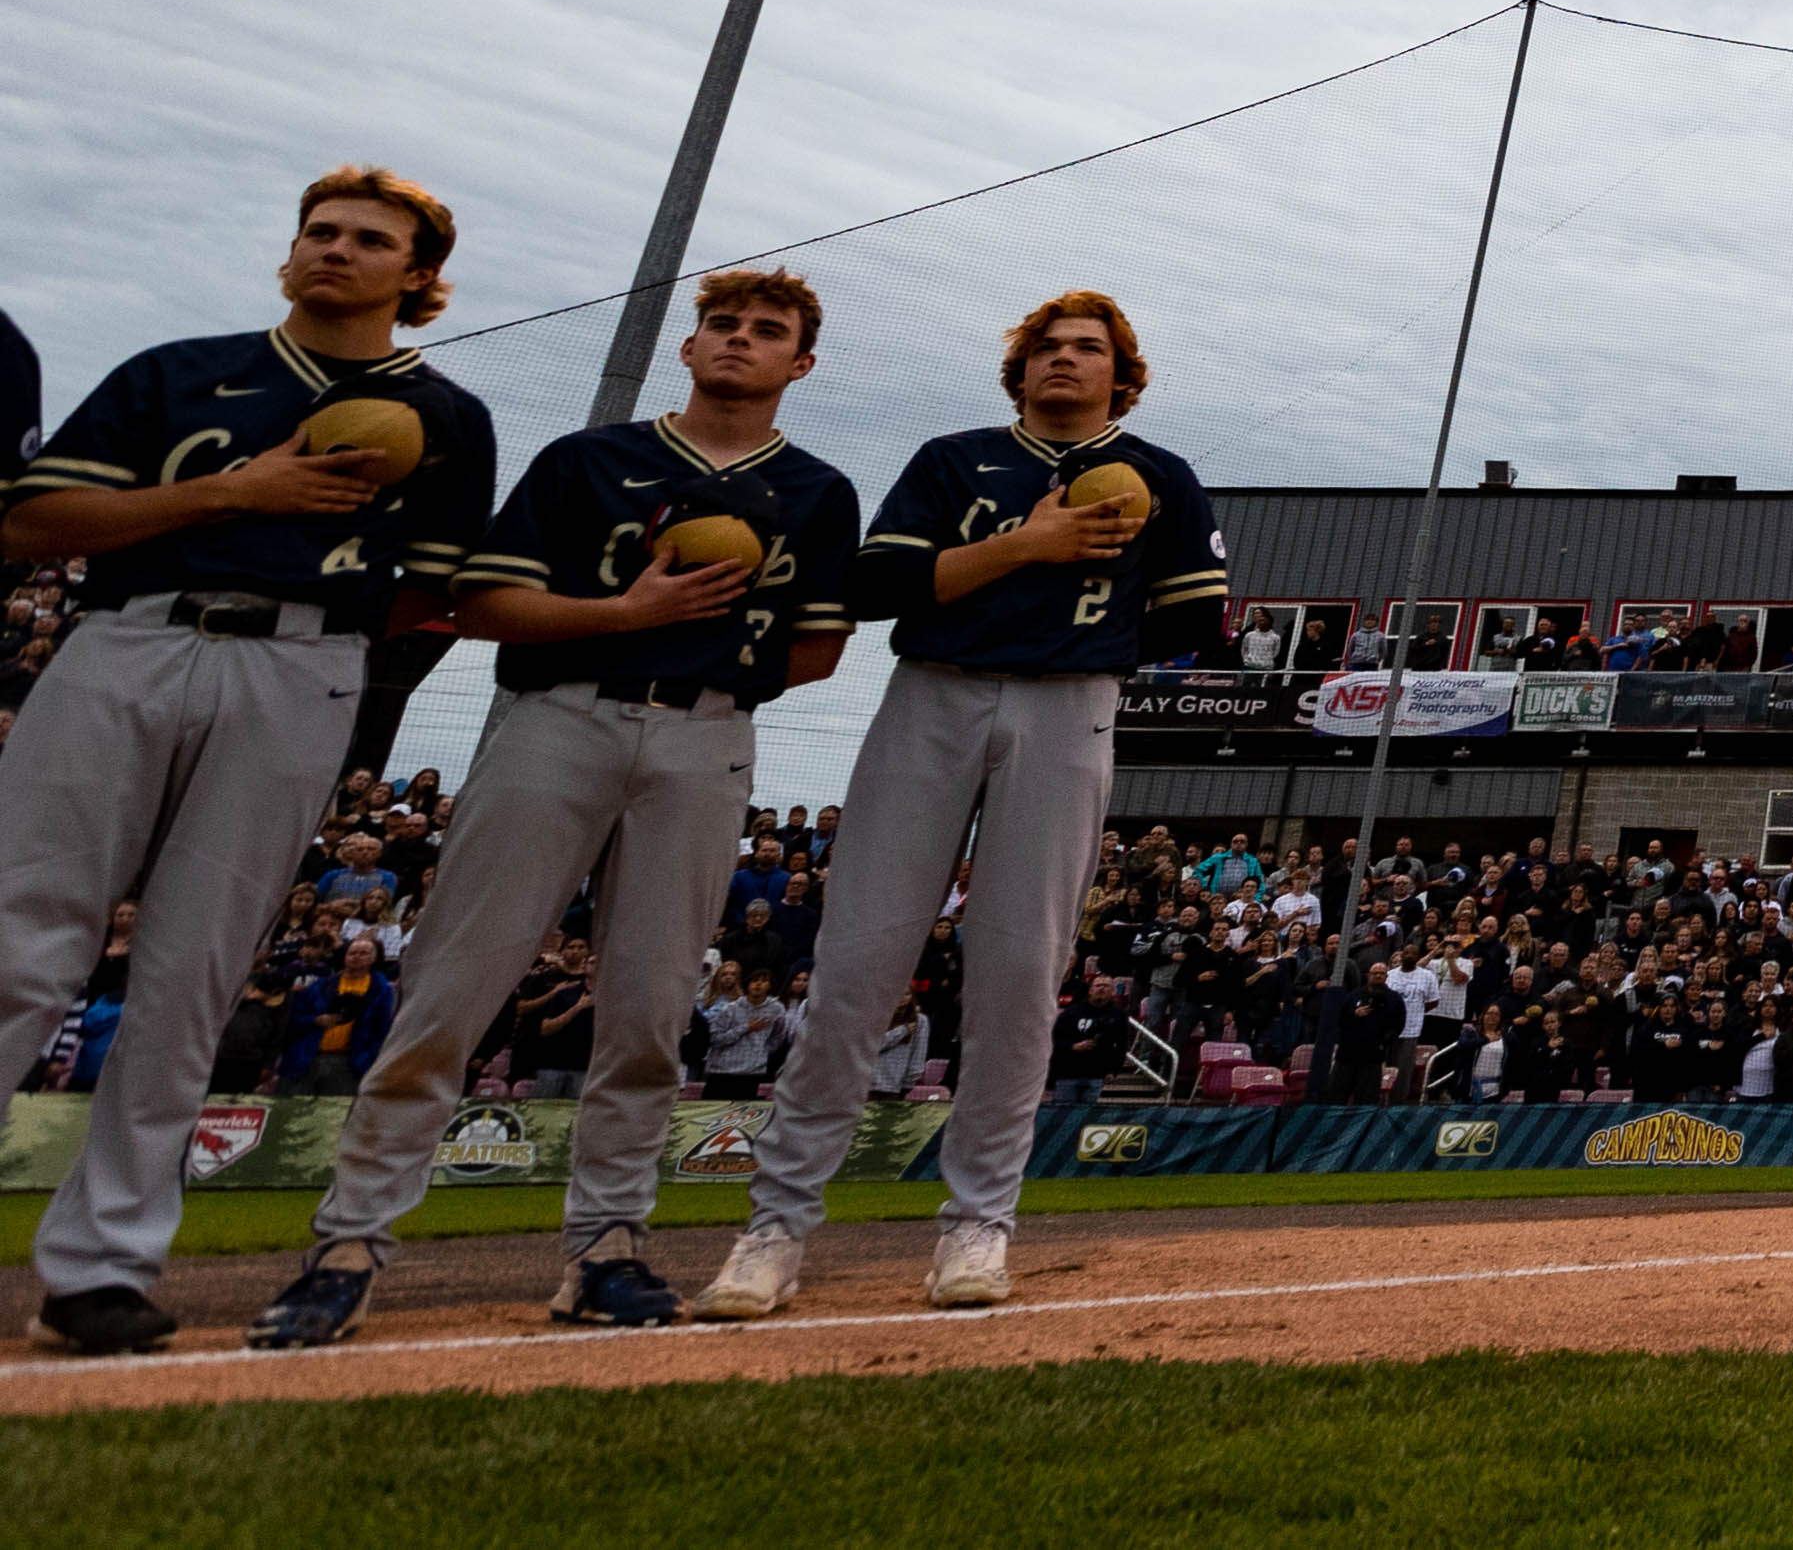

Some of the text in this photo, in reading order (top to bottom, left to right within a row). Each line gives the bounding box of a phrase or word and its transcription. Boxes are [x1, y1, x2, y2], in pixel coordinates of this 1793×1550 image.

[1072, 578, 1112, 626] 2
[1412, 680, 1486, 688] Northwest
[1176, 694, 1268, 715] GROUP
[1411, 689, 1457, 701] Sports
[1524, 684, 1609, 714] DICK'S
[1408, 702, 1497, 716] Photography
[1586, 1111, 1743, 1163] CAMPESINOS
